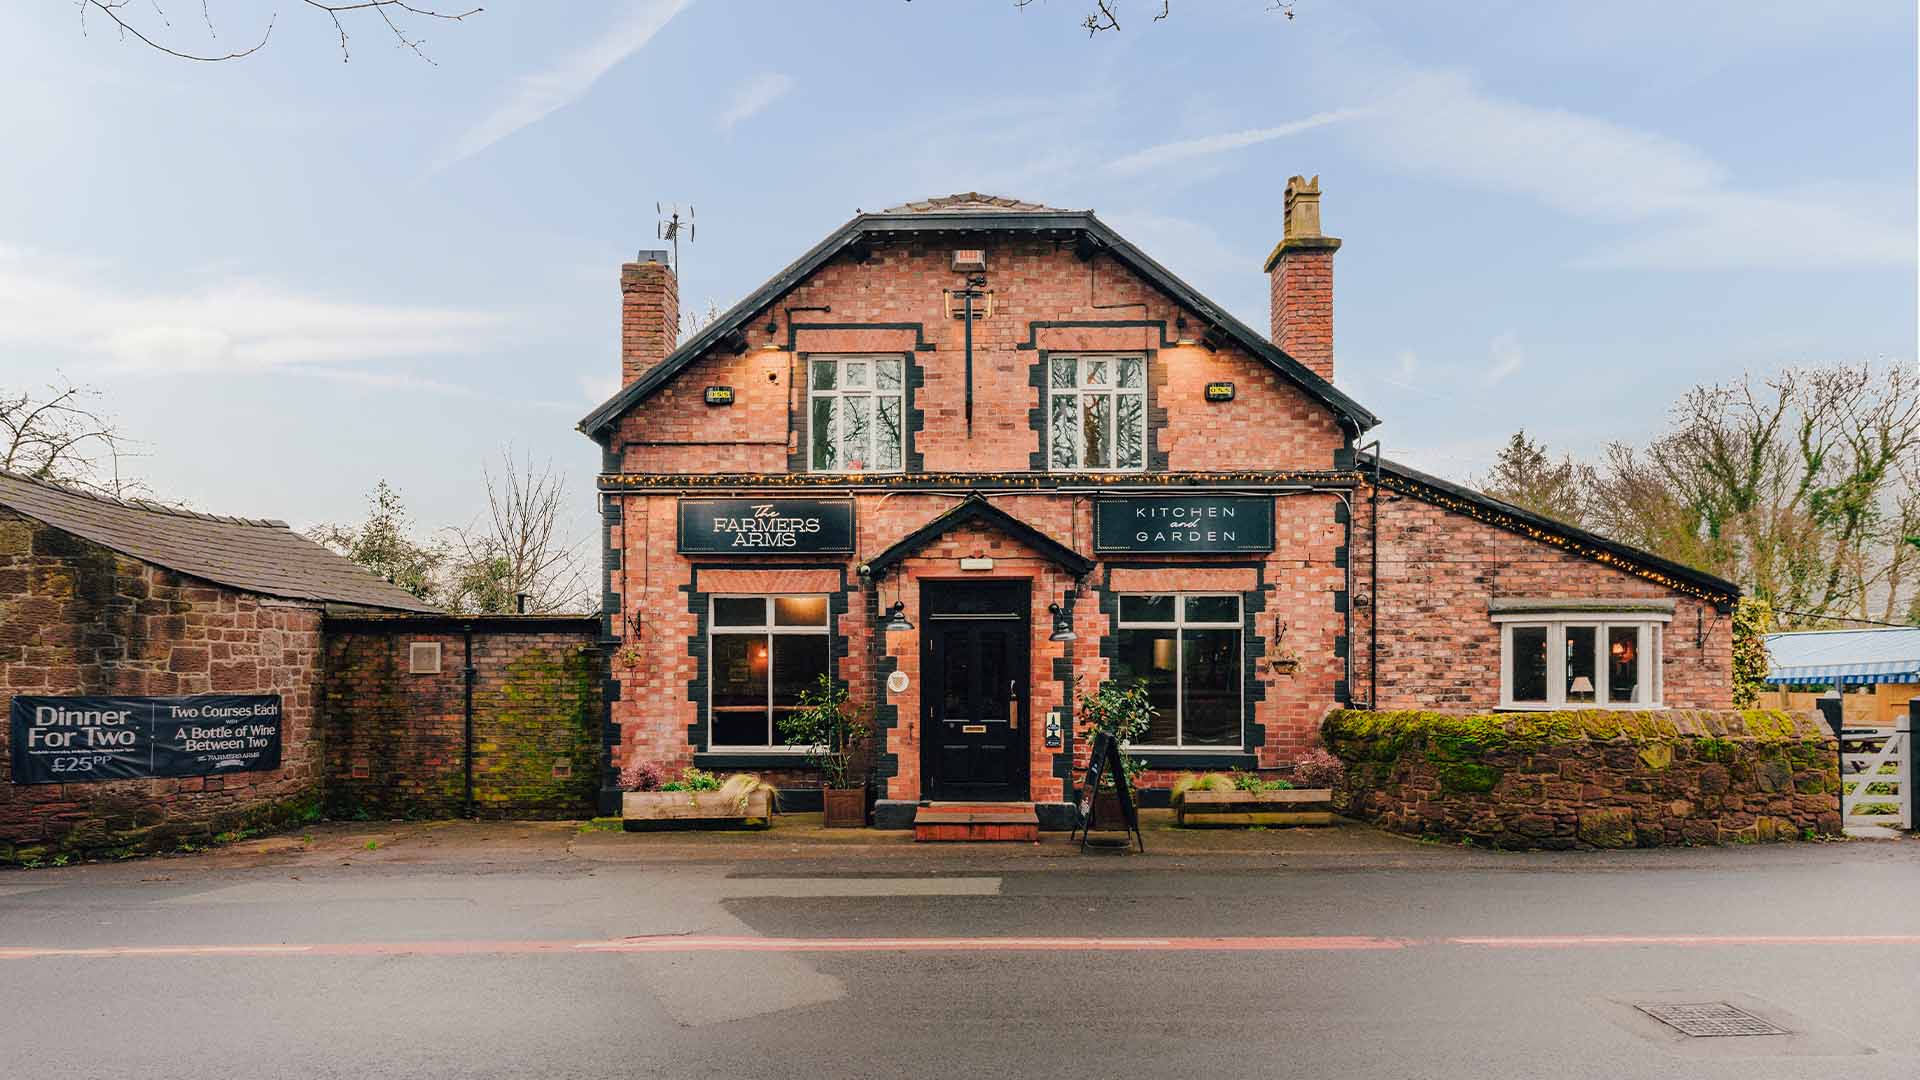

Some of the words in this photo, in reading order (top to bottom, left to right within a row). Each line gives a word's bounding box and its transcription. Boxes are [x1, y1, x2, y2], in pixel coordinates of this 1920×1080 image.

[751, 504, 780, 518] The
[1136, 507, 1235, 517] KITCHEN
[713, 518, 821, 533] FARMERS
[1169, 518, 1201, 528] and
[731, 533, 797, 547] ARMS
[1136, 531, 1236, 542] GARDEN
[36, 706, 132, 726] Dinner
[169, 705, 197, 718] Two
[202, 705, 252, 718] Courses
[254, 703, 278, 716] Each
[28, 728, 77, 747] For
[80, 726, 136, 747] Two
[175, 728, 187, 740] A
[192, 726, 233, 739] Bottle
[235, 725, 249, 737] of
[250, 724, 276, 736] Wine
[185, 738, 244, 752] Between
[247, 736, 268, 748] Two
